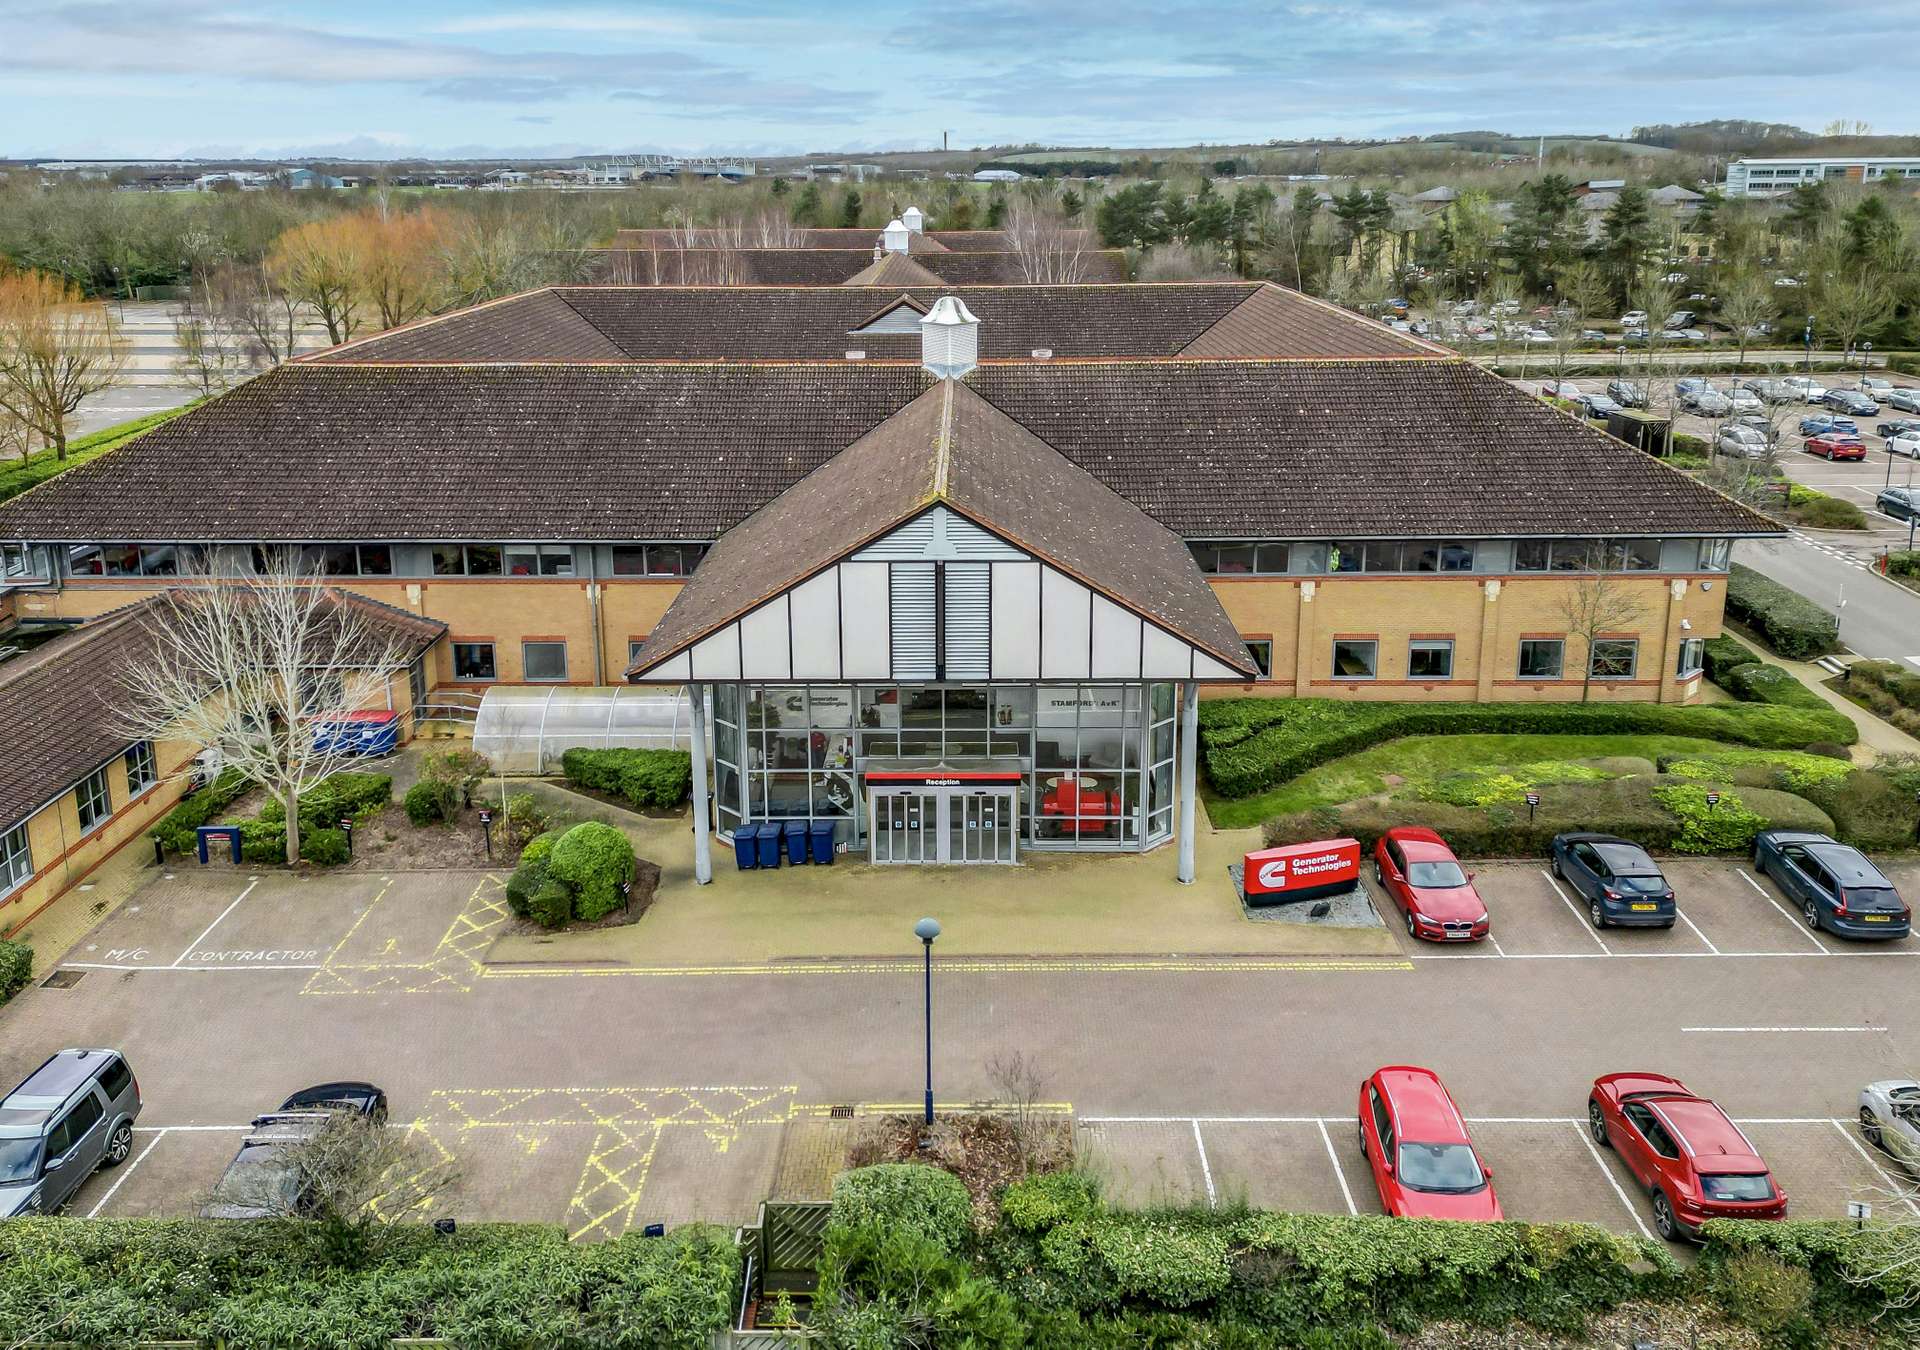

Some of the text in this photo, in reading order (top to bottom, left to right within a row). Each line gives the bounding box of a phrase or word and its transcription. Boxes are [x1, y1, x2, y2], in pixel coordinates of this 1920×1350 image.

[1292, 854, 1339, 867] Generator
[1292, 860, 1352, 876] Technologies
[105, 948, 149, 961] M/C
[189, 950, 318, 961] CONTRACTOR
